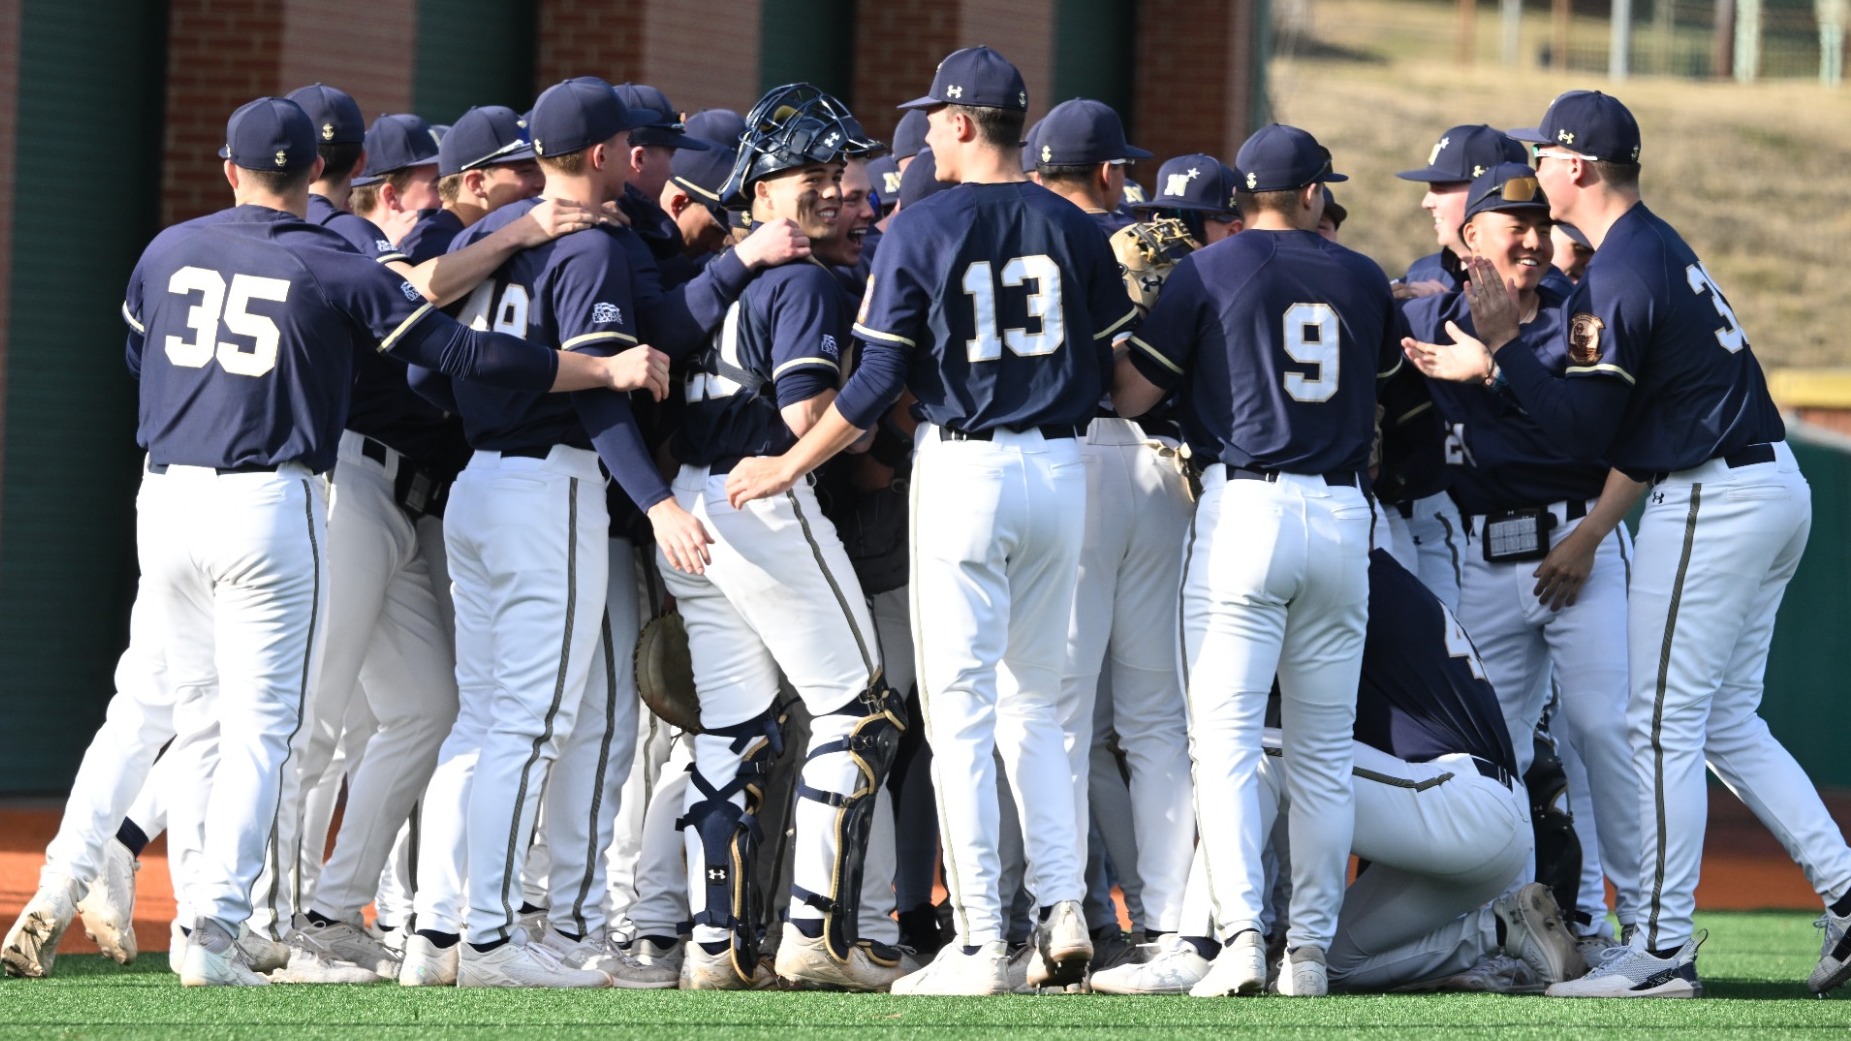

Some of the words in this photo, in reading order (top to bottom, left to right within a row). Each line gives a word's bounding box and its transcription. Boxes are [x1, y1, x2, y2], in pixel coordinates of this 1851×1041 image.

[164, 265, 291, 378] 35
[962, 253, 1065, 363] 13
[1282, 302, 1340, 402] 9
[1686, 261, 1748, 354] 3
[1438, 600, 1488, 681] 4
